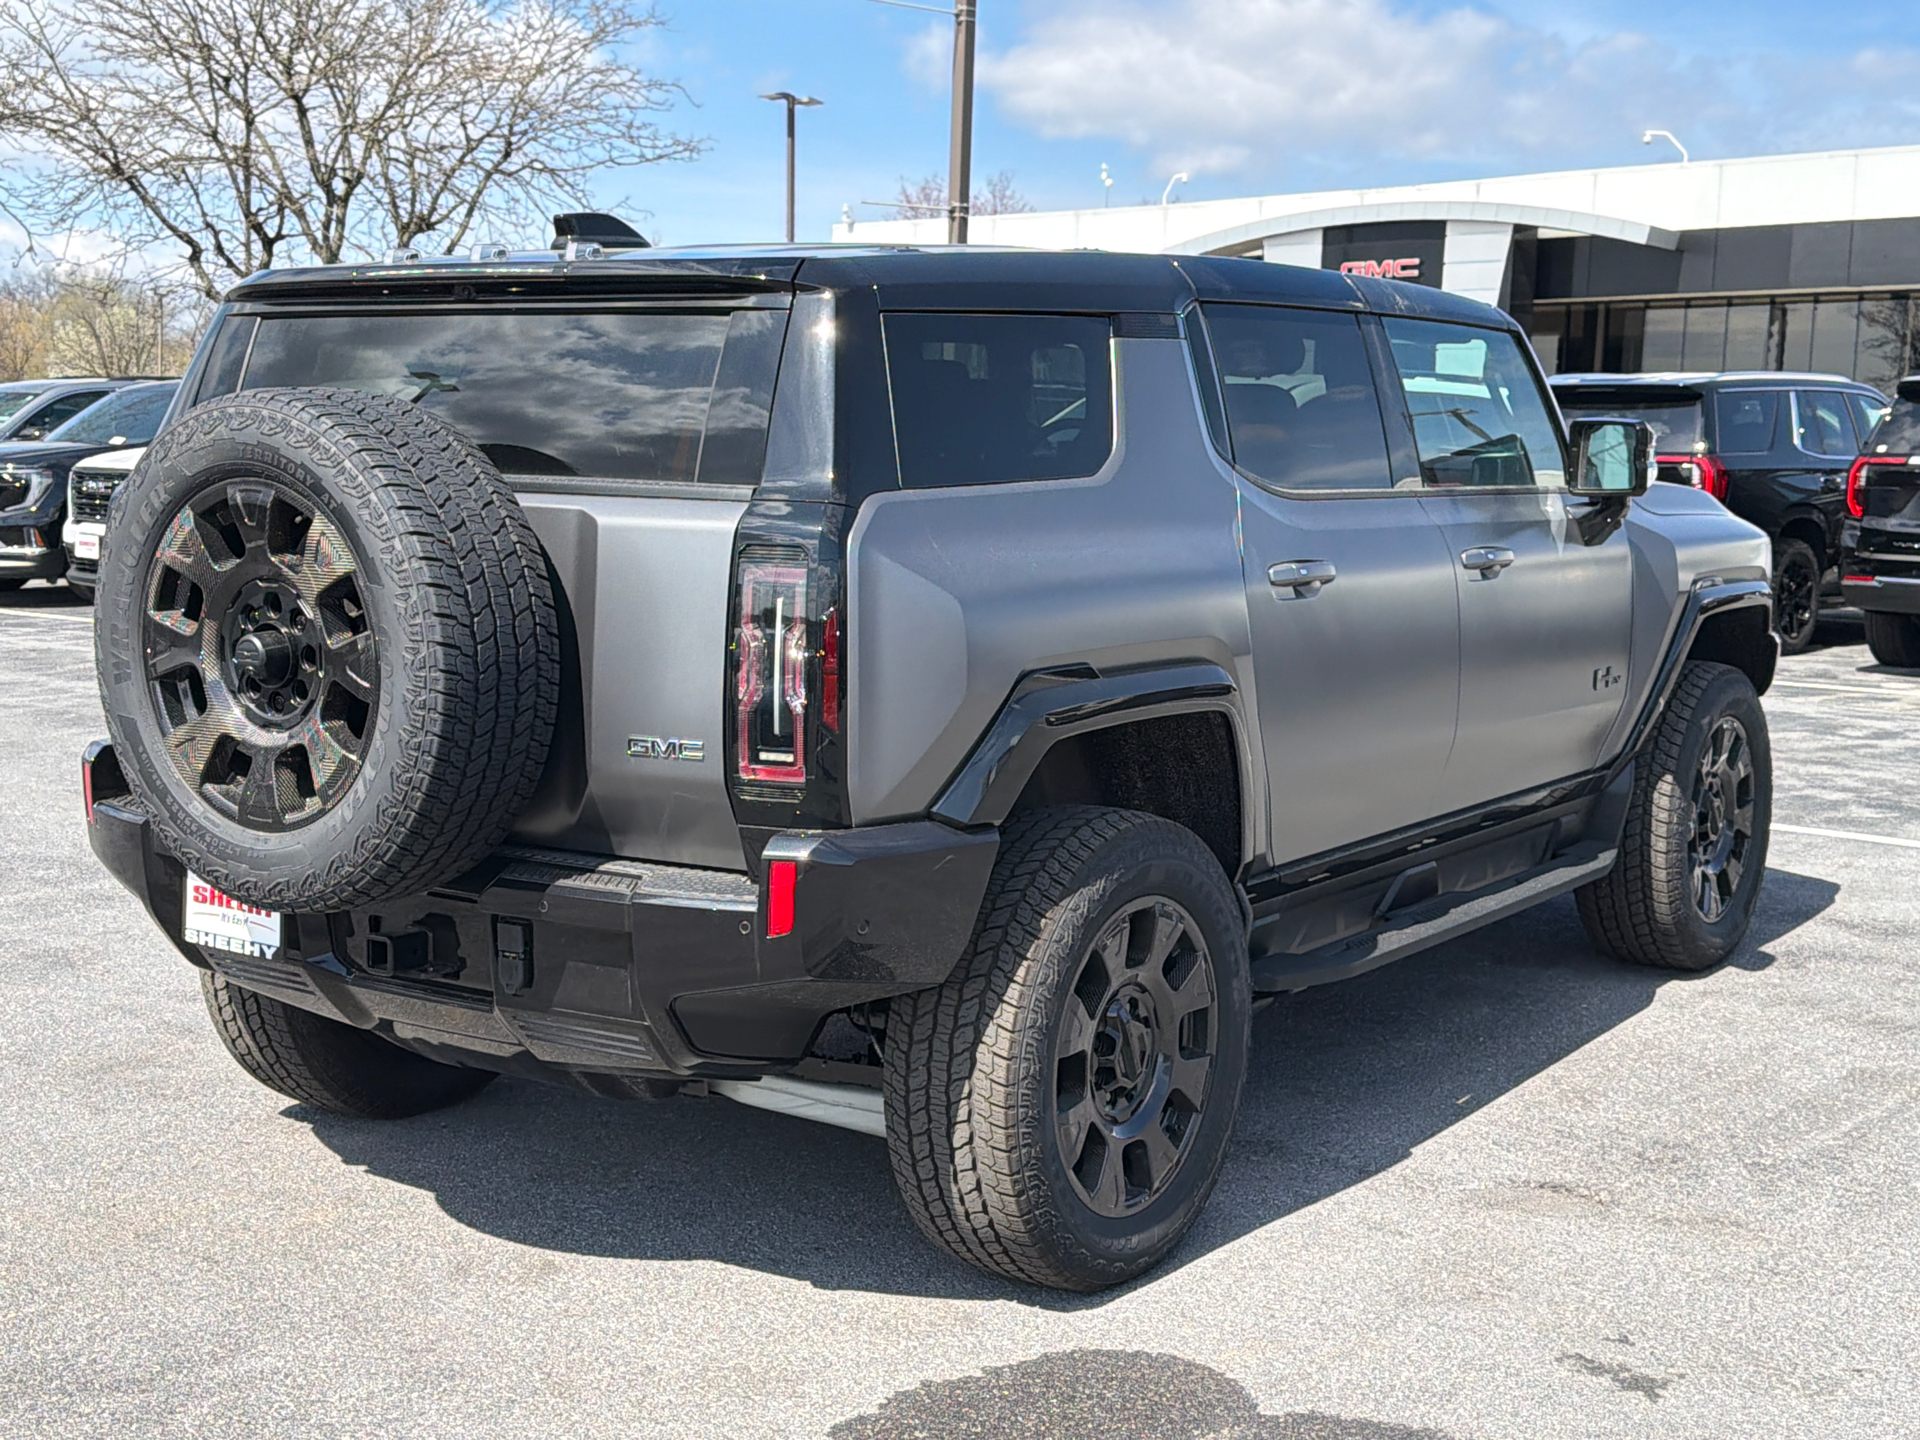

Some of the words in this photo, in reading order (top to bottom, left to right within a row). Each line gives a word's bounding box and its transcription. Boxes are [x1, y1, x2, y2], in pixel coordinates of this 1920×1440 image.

[1340, 258, 1420, 278] GMC
[238, 443, 315, 486] TERRITORY
[320, 492, 339, 510] AT
[110, 482, 172, 686] WRANGLER
[627, 735, 704, 761] GMC
[184, 929, 277, 960] SHEEHY
